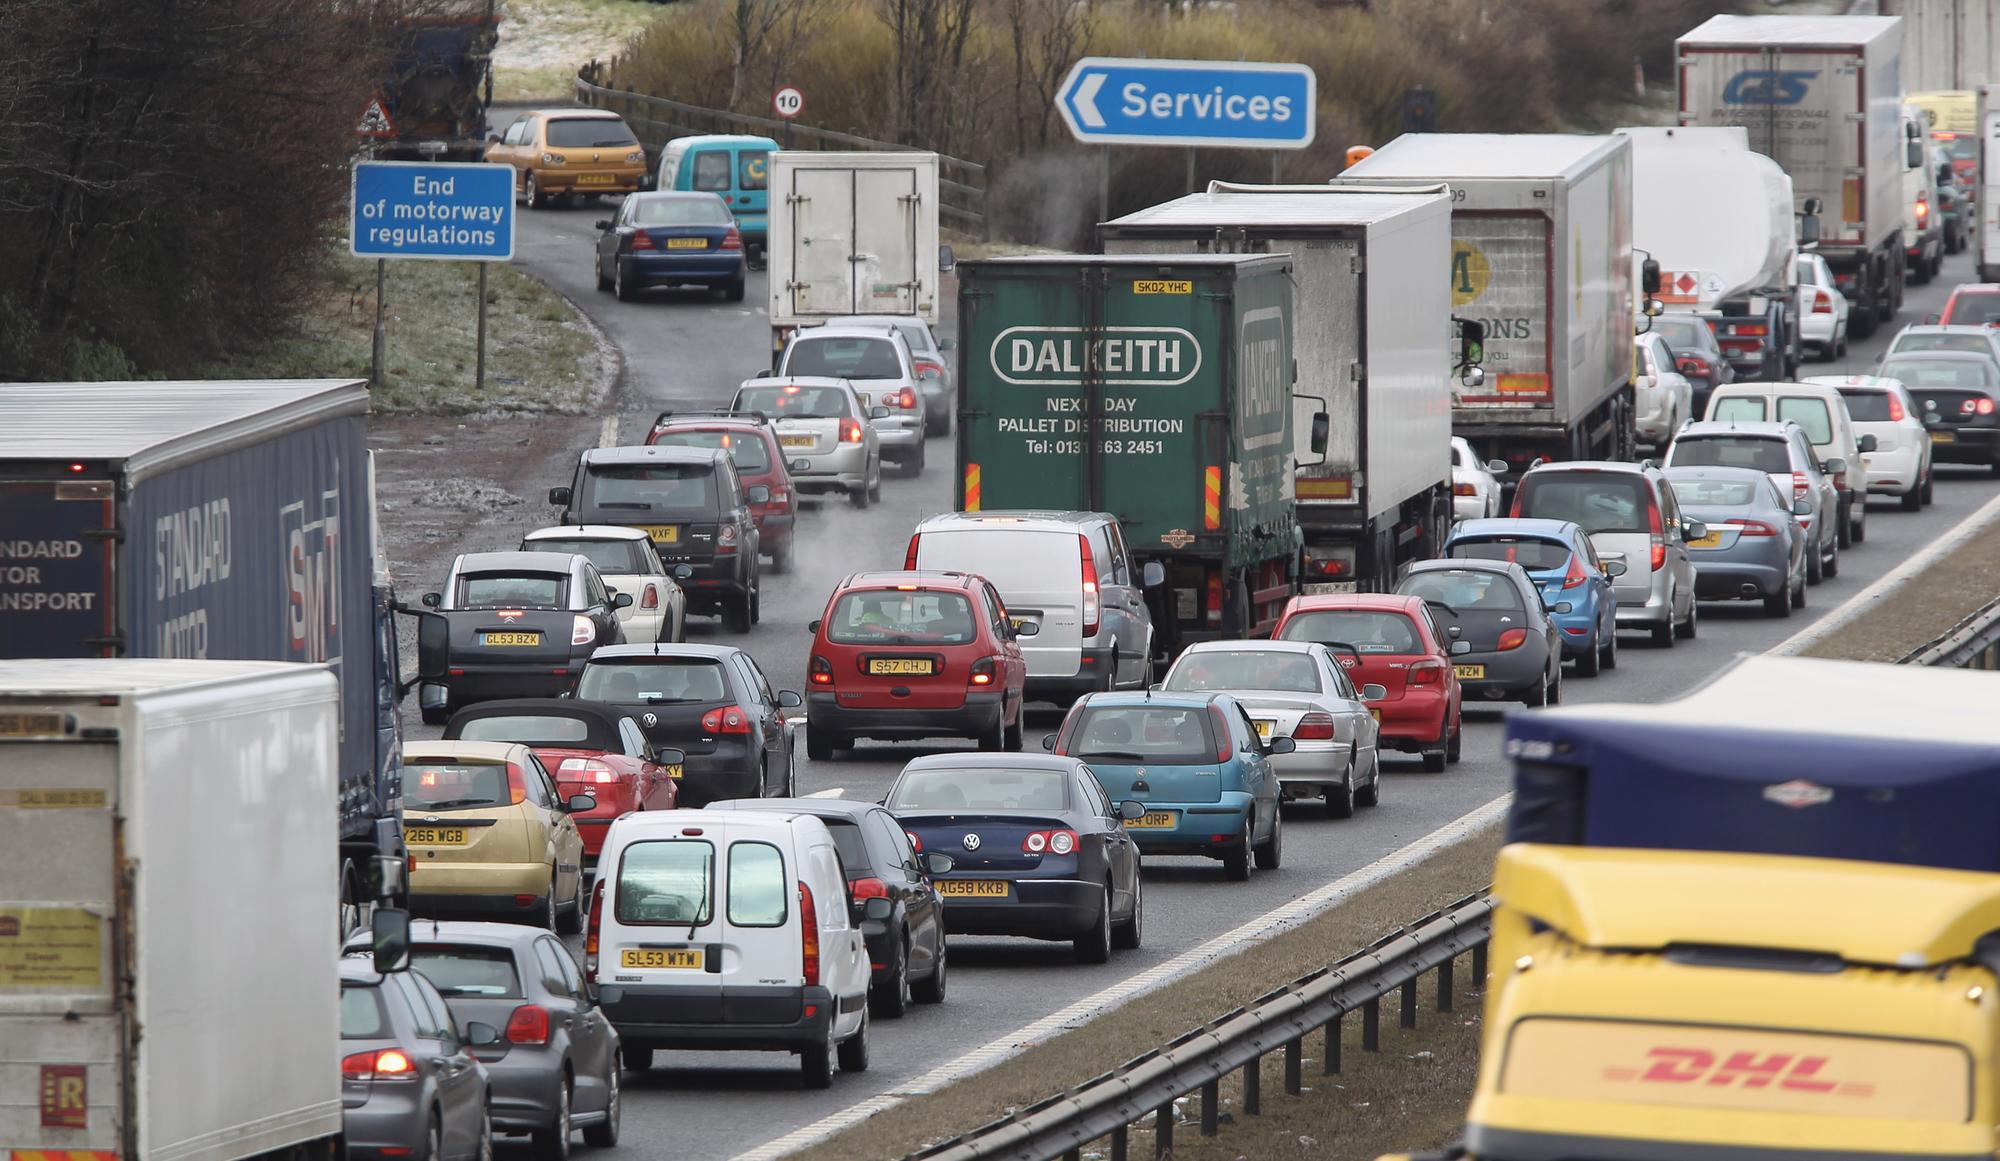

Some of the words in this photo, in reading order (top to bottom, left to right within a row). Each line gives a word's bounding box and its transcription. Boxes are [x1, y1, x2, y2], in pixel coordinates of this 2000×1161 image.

[778, 95, 799, 108] 10
[1121, 82, 1292, 121] Services
[414, 176, 455, 196] End
[362, 199, 387, 219] of
[394, 200, 504, 225] motorway
[369, 225, 496, 247] regulations
[1138, 282, 1165, 292] SK02
[1168, 282, 1188, 292] YHC
[1011, 338, 1180, 373] DALKEITH
[1105, 398, 1137, 411] DAY
[998, 418, 1059, 433] PALLET
[1065, 418, 1183, 433] DISRIBUTION
[1026, 440, 1053, 454] Tel:
[1127, 440, 1163, 454] 2451
[651, 528, 671, 538] VXF
[1, 540, 83, 558] NDARD
[0, 592, 97, 610] NSPORT
[486, 634, 514, 644] GL53
[516, 634, 537, 644] BZX
[876, 661, 900, 672] S57
[903, 661, 927, 672] CHJ
[1145, 814, 1169, 825] ORP
[404, 830, 434, 842] Y266
[438, 830, 463, 842] WGB
[940, 881, 974, 894] AG58
[977, 881, 1004, 894] KKB
[627, 951, 664, 966] SL53
[667, 951, 695, 966] WTW
[1641, 1046, 1838, 1094] DHL
[60, 1076, 85, 1109] R
